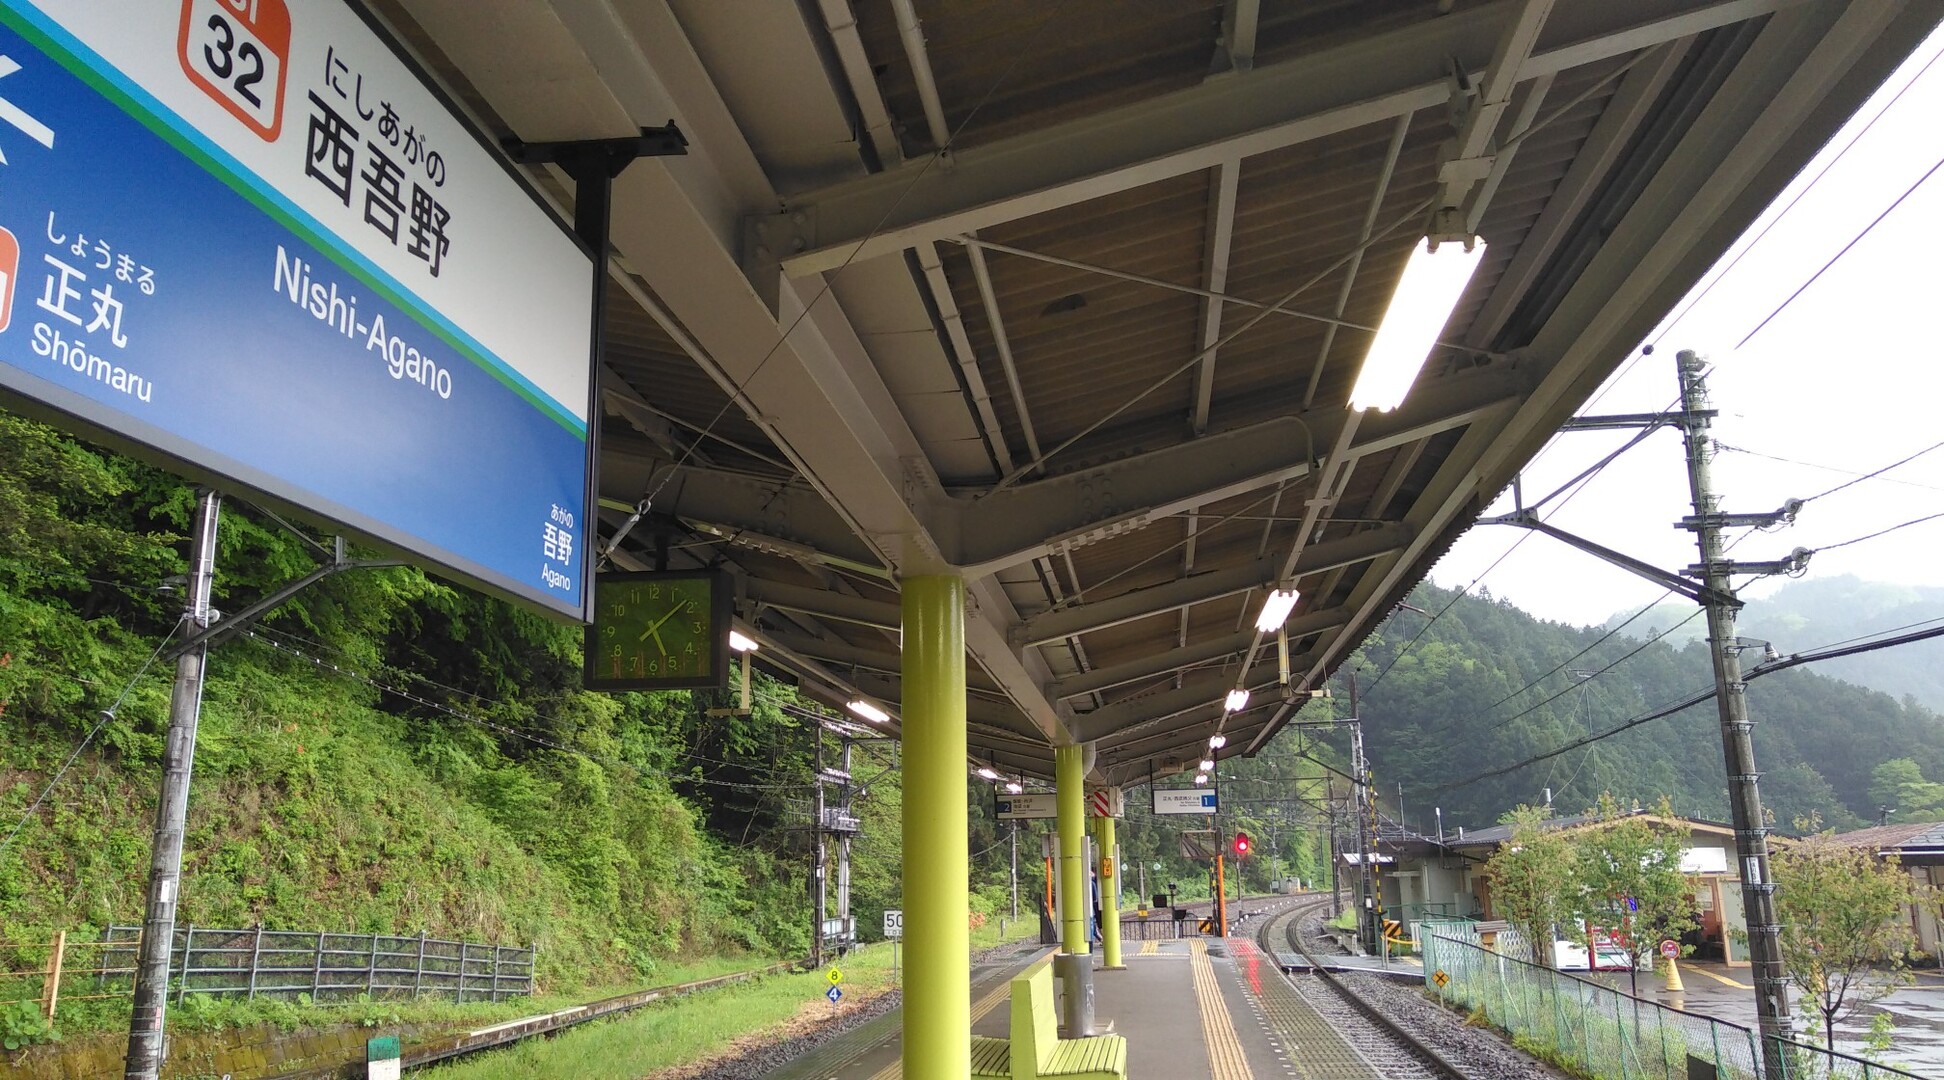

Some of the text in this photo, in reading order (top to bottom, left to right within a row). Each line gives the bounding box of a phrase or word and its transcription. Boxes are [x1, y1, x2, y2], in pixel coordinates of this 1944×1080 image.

[203, 14, 265, 110] 32
[325, 44, 446, 188] にしあがの
[304, 88, 451, 278] 西吾野
[47, 210, 155, 296] しょうまる
[36, 253, 128, 349] 正丸
[273, 244, 452, 400] Nishi-Agano
[31, 321, 153, 403] Shōmaru
[550, 502, 574, 529] あがの
[542, 521, 573, 566] 吾野
[541, 562, 571, 591] Agano
[631, 591, 640, 604] 11
[649, 587, 660, 600] 12
[614, 604, 625, 617] 10
[686, 601, 694, 614] 2
[606, 625, 616, 638] 9
[693, 621, 701, 634] 3
[613, 644, 622, 657] 8
[685, 641, 694, 654] 4
[630, 657, 638, 668] 7
[649, 659, 658, 672] 6
[668, 656, 677, 668] 5
[1004, 803, 1010, 812] 2
[831, 970, 838, 981] 8
[828, 987, 839, 1000] 4
